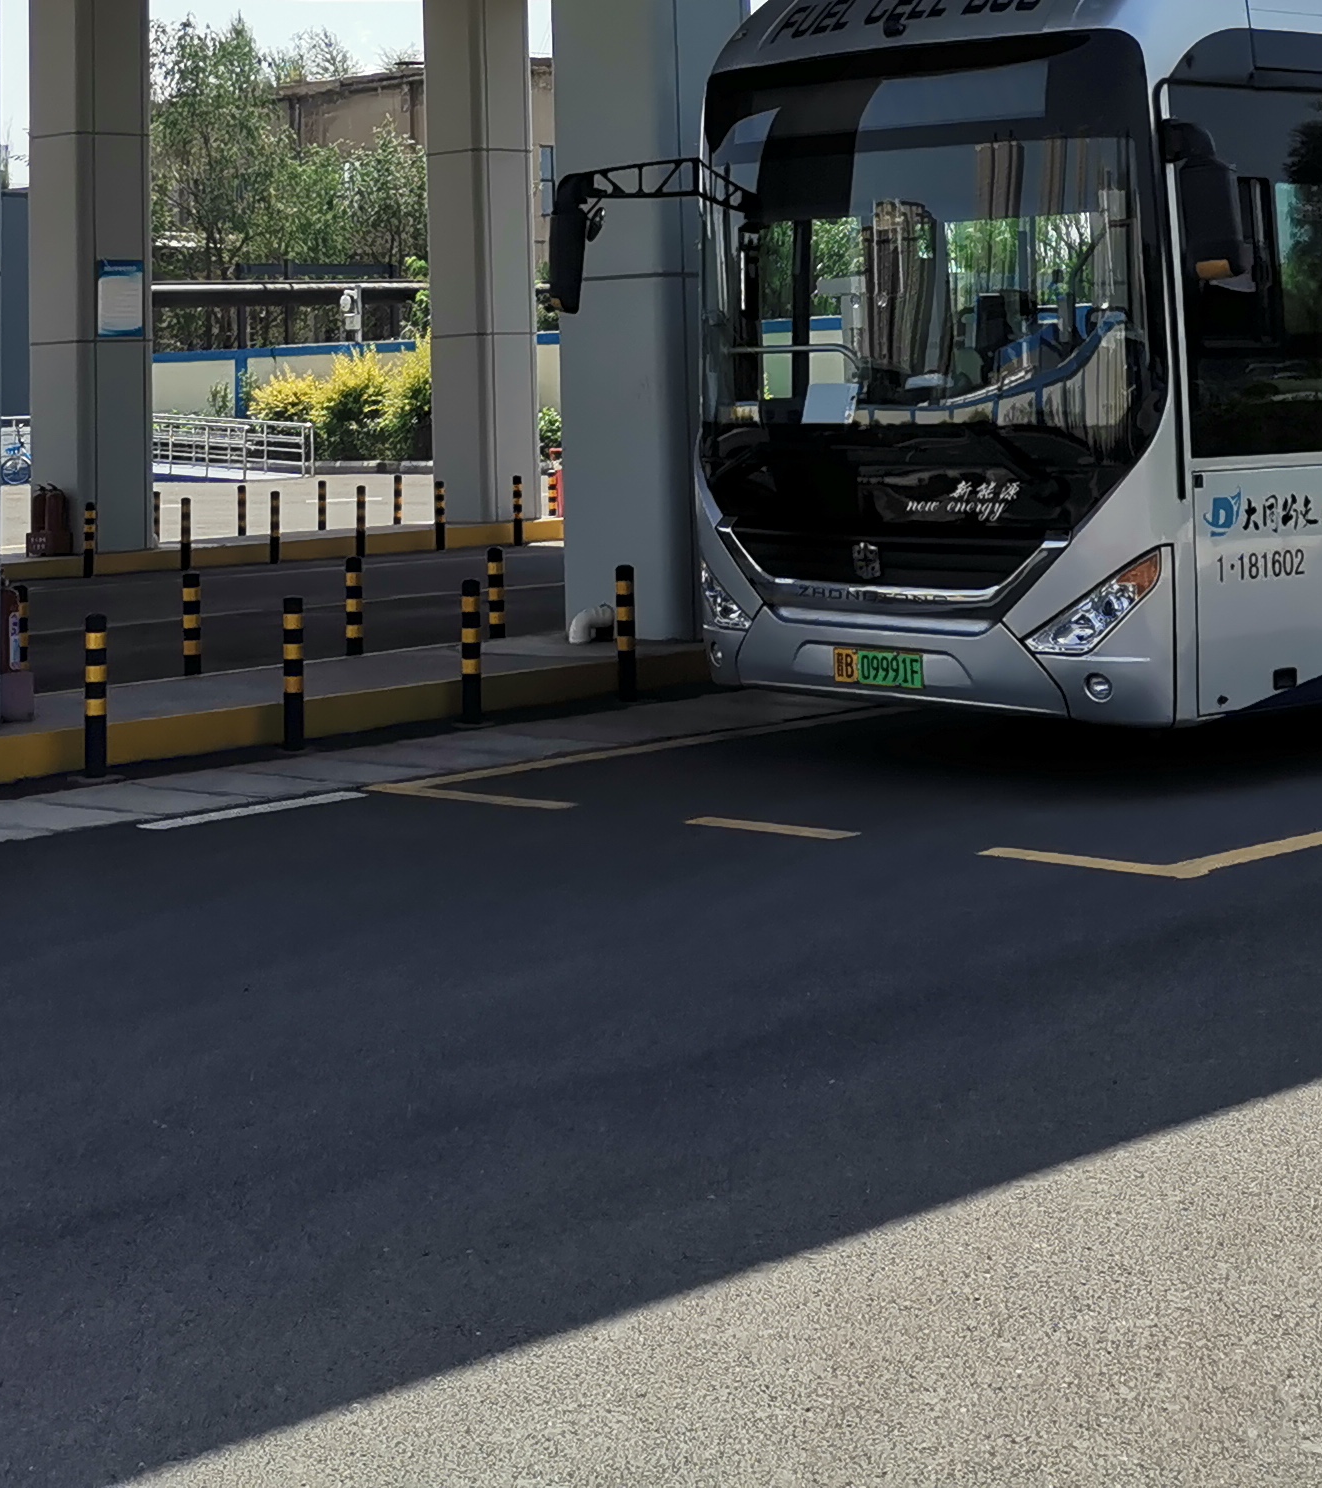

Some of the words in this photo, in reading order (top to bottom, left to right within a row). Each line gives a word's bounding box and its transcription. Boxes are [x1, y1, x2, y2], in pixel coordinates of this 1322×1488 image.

[949, 480, 1020, 501] 新能源
[906, 500, 939, 512] new
[946, 500, 1009, 522] energy
[1243, 493, 1319, 533] 大同公交
